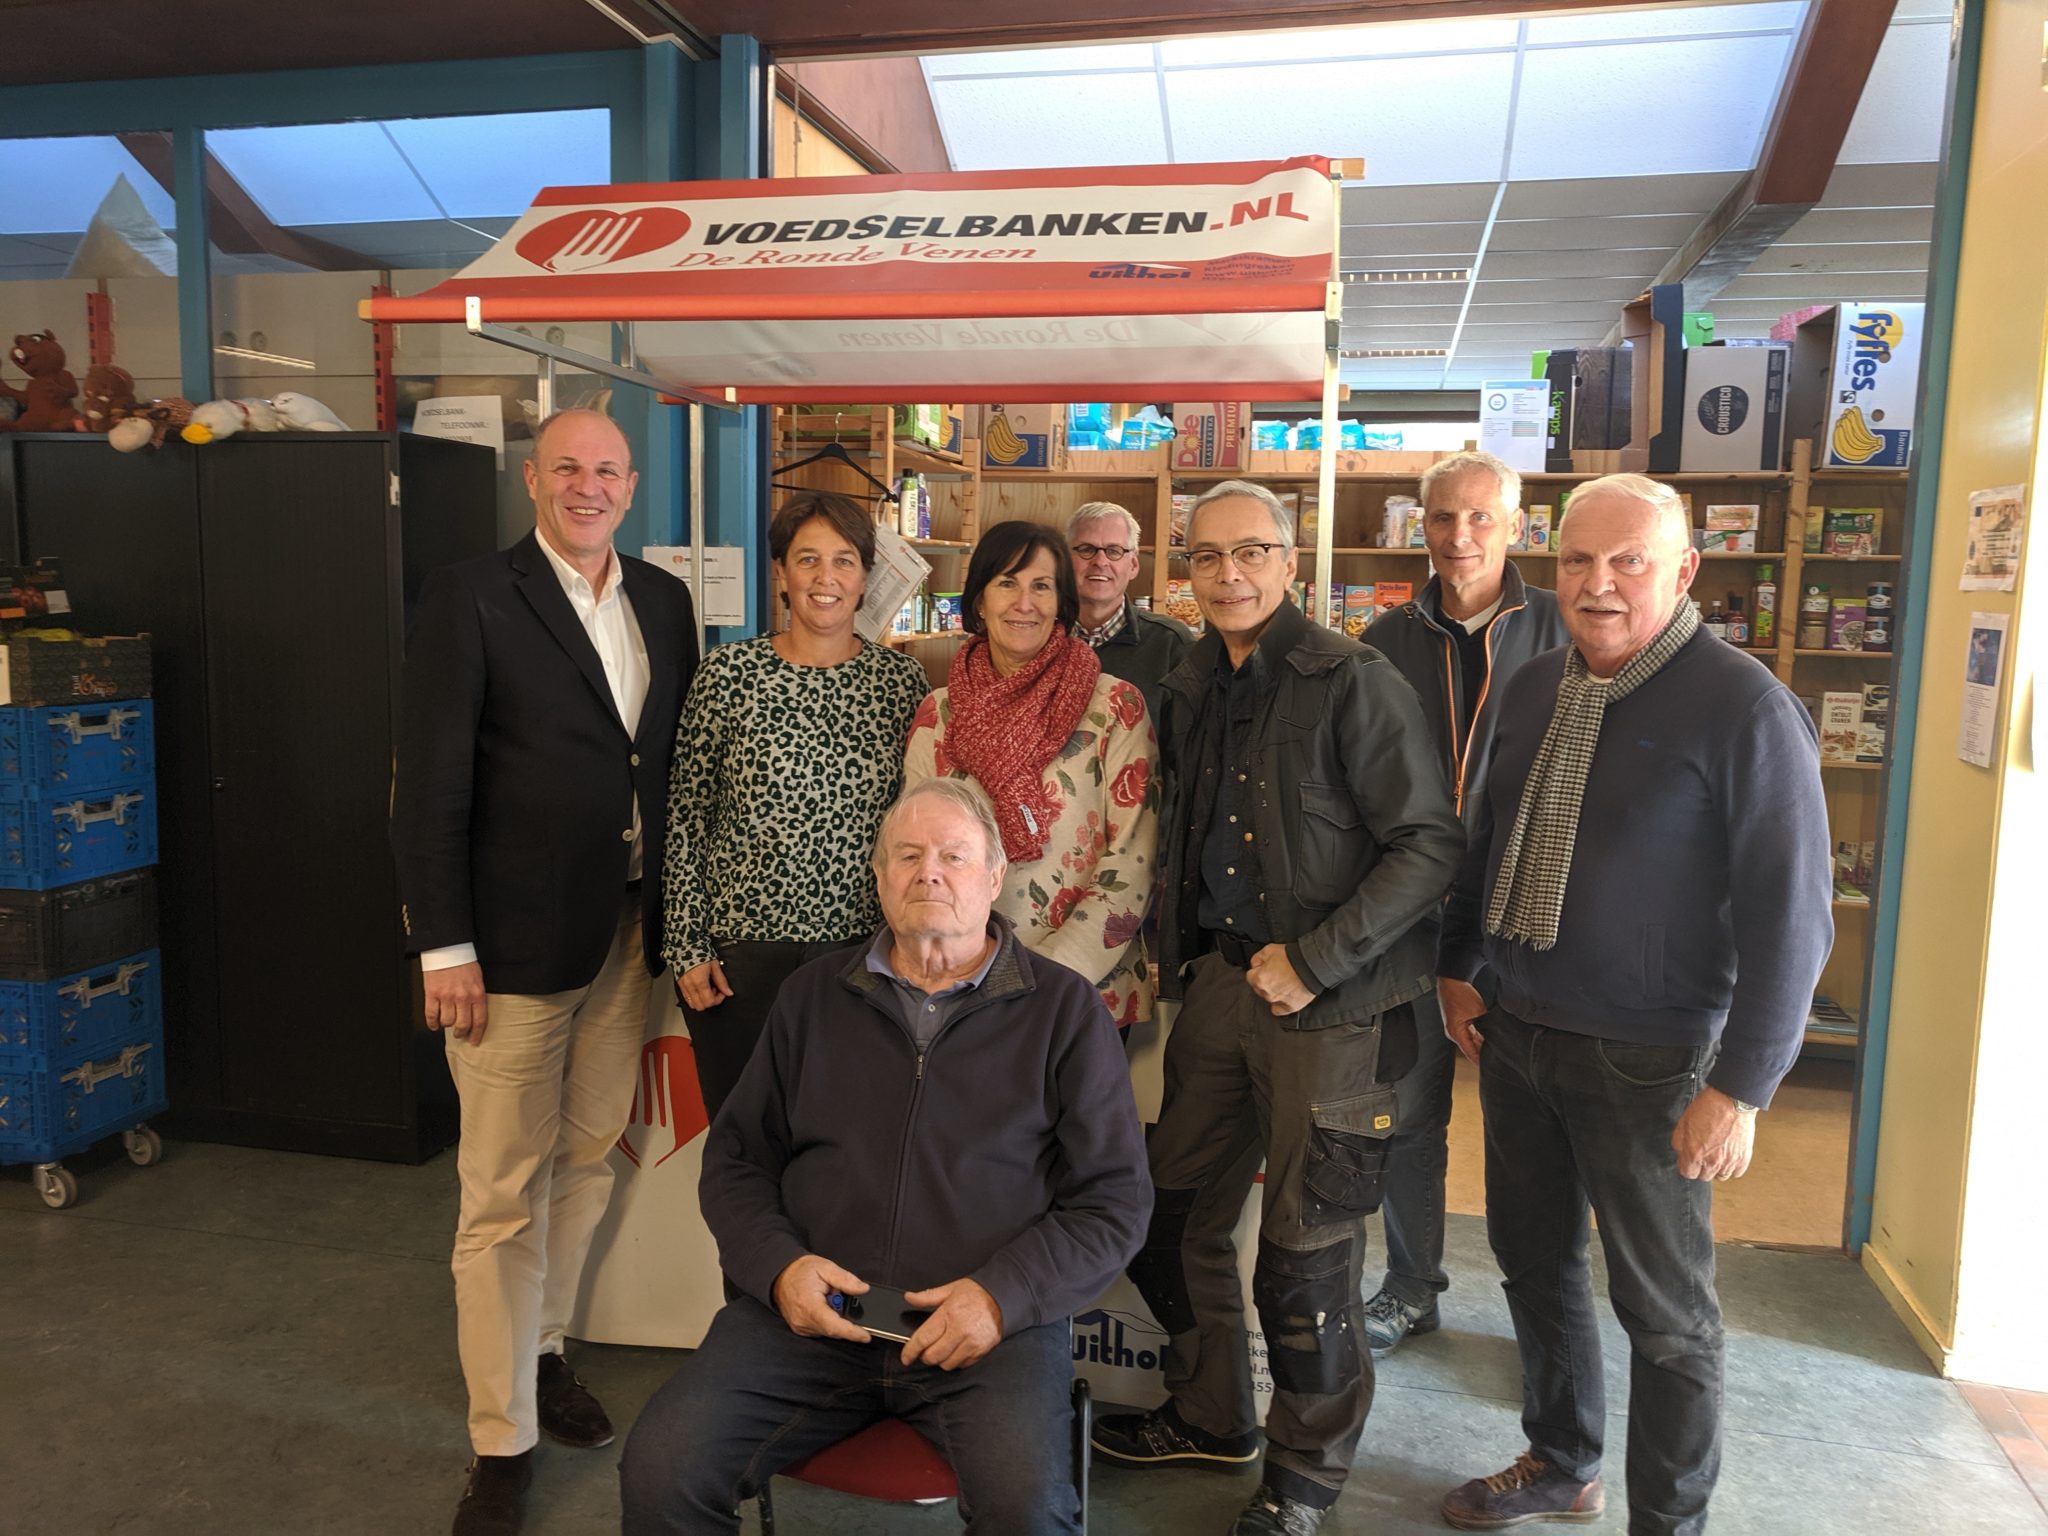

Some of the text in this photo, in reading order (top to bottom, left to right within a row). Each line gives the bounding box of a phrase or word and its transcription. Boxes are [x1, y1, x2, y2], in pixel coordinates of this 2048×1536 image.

[703, 192, 1309, 245] VOEDSELBANKEN.NL
[670, 242, 1037, 267] De Ronde Venen
[1226, 402, 1237, 448] PREMIU
[1548, 390, 1566, 435] Kamps
[1717, 387, 1732, 434] CROUSTICO
[1895, 431, 1909, 466] Bananas
